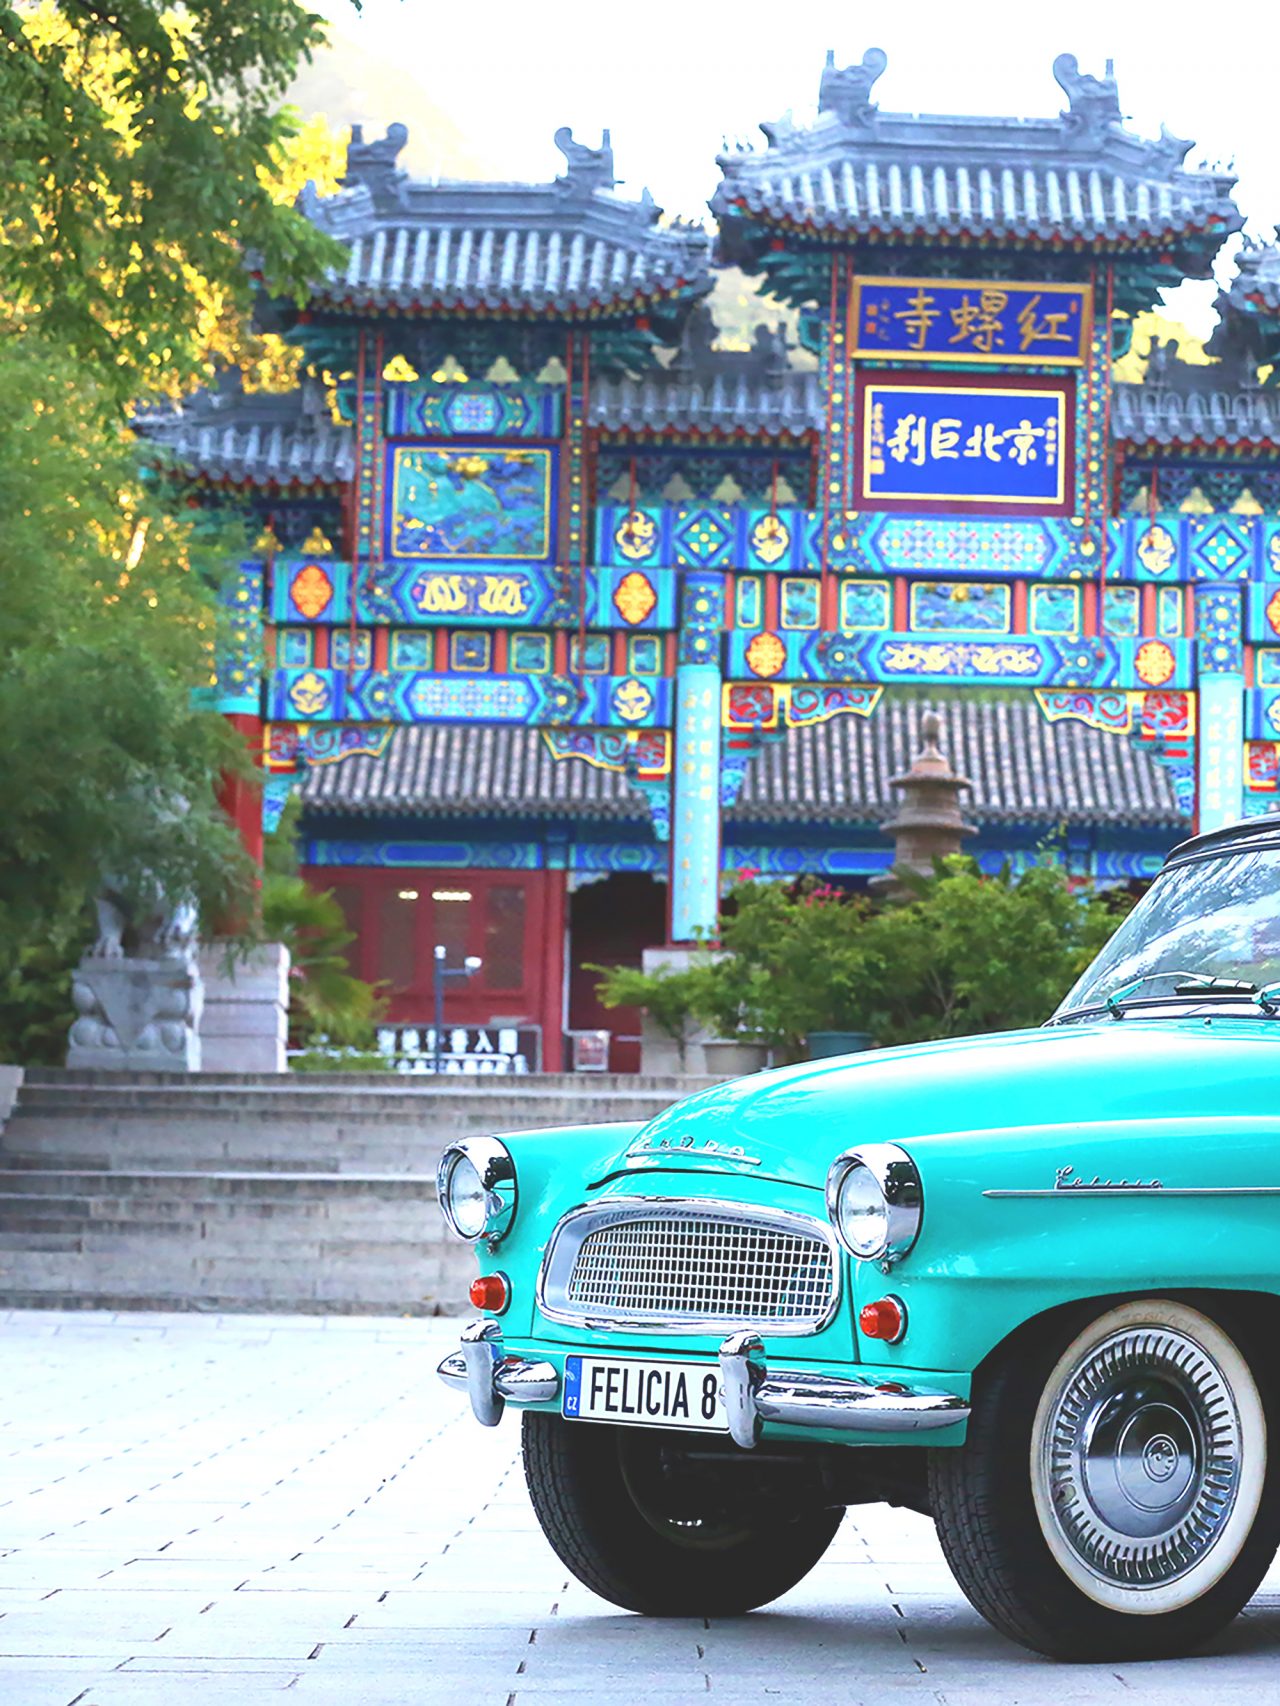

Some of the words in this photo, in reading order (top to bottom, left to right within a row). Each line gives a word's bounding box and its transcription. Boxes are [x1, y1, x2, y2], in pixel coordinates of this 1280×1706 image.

[566, 1396, 578, 1411] CZ
[589, 1366, 690, 1418] FELICIA
[701, 1373, 718, 1420] 8
